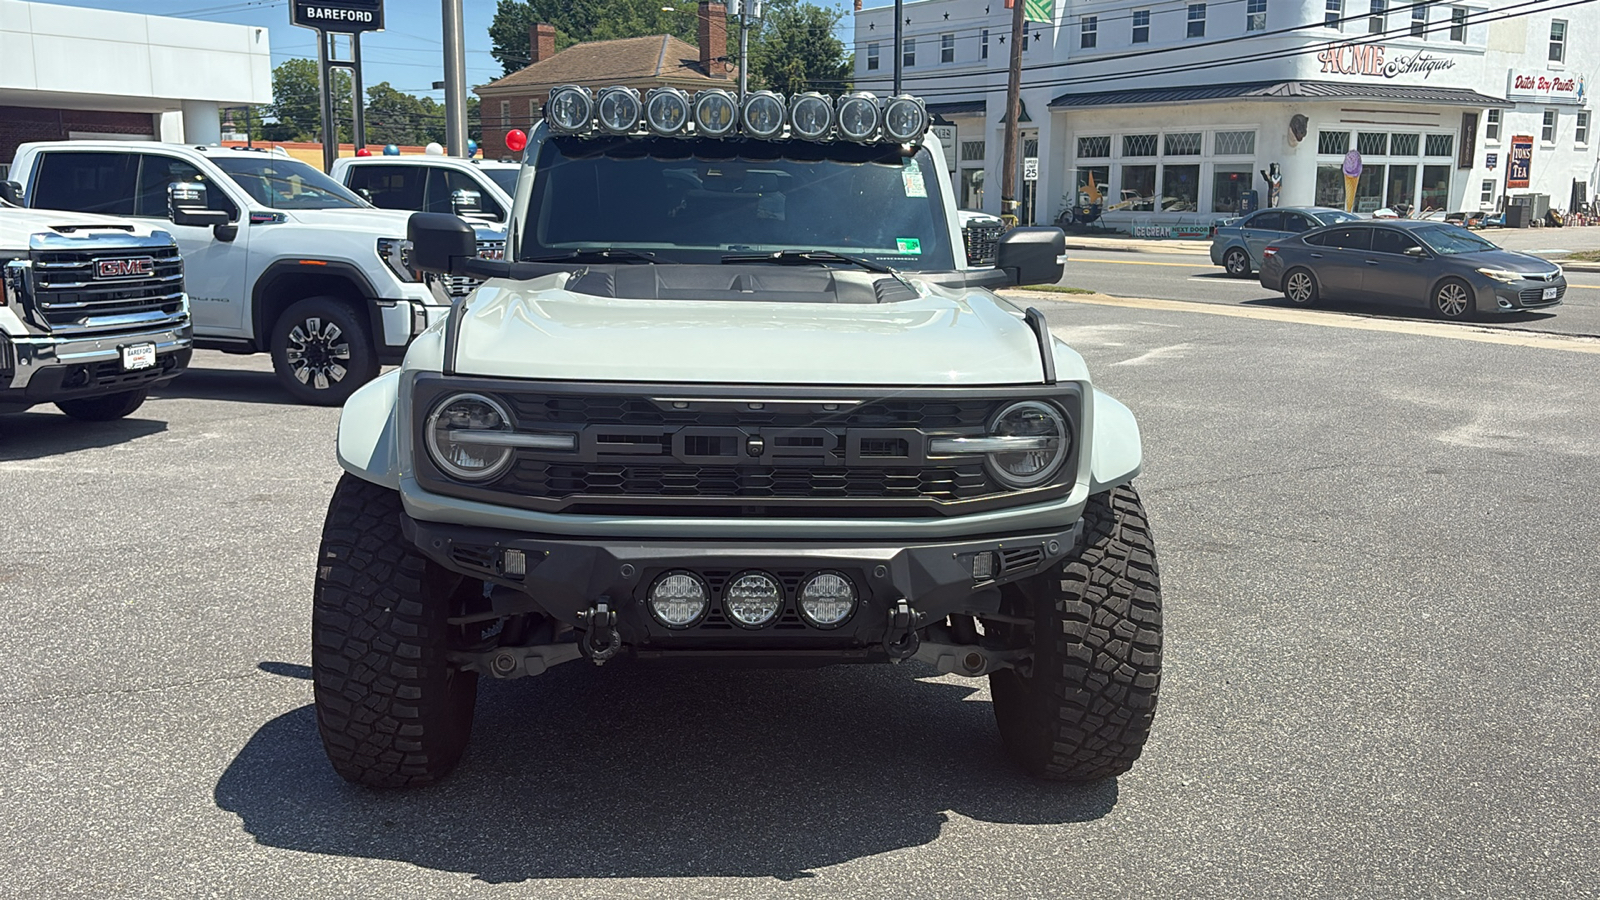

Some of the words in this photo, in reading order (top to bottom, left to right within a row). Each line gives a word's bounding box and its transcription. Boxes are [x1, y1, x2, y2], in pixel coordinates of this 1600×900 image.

[307, 7, 372, 22] BAREFORD
[1317, 42, 1386, 76] ACME
[1400, 49, 1456, 79] Antiques
[1515, 74, 1535, 89] Dutch
[1537, 76, 1552, 93] Boy
[1552, 77, 1575, 92] Paints
[1026, 169, 1037, 178] 25
[1513, 165, 1527, 178] TEA
[1134, 226, 1145, 237] ICE
[1146, 226, 1171, 238] CREAM
[99, 259, 153, 276] GMC
[127, 347, 152, 356] BAREFORD
[583, 424, 924, 466] FORD
